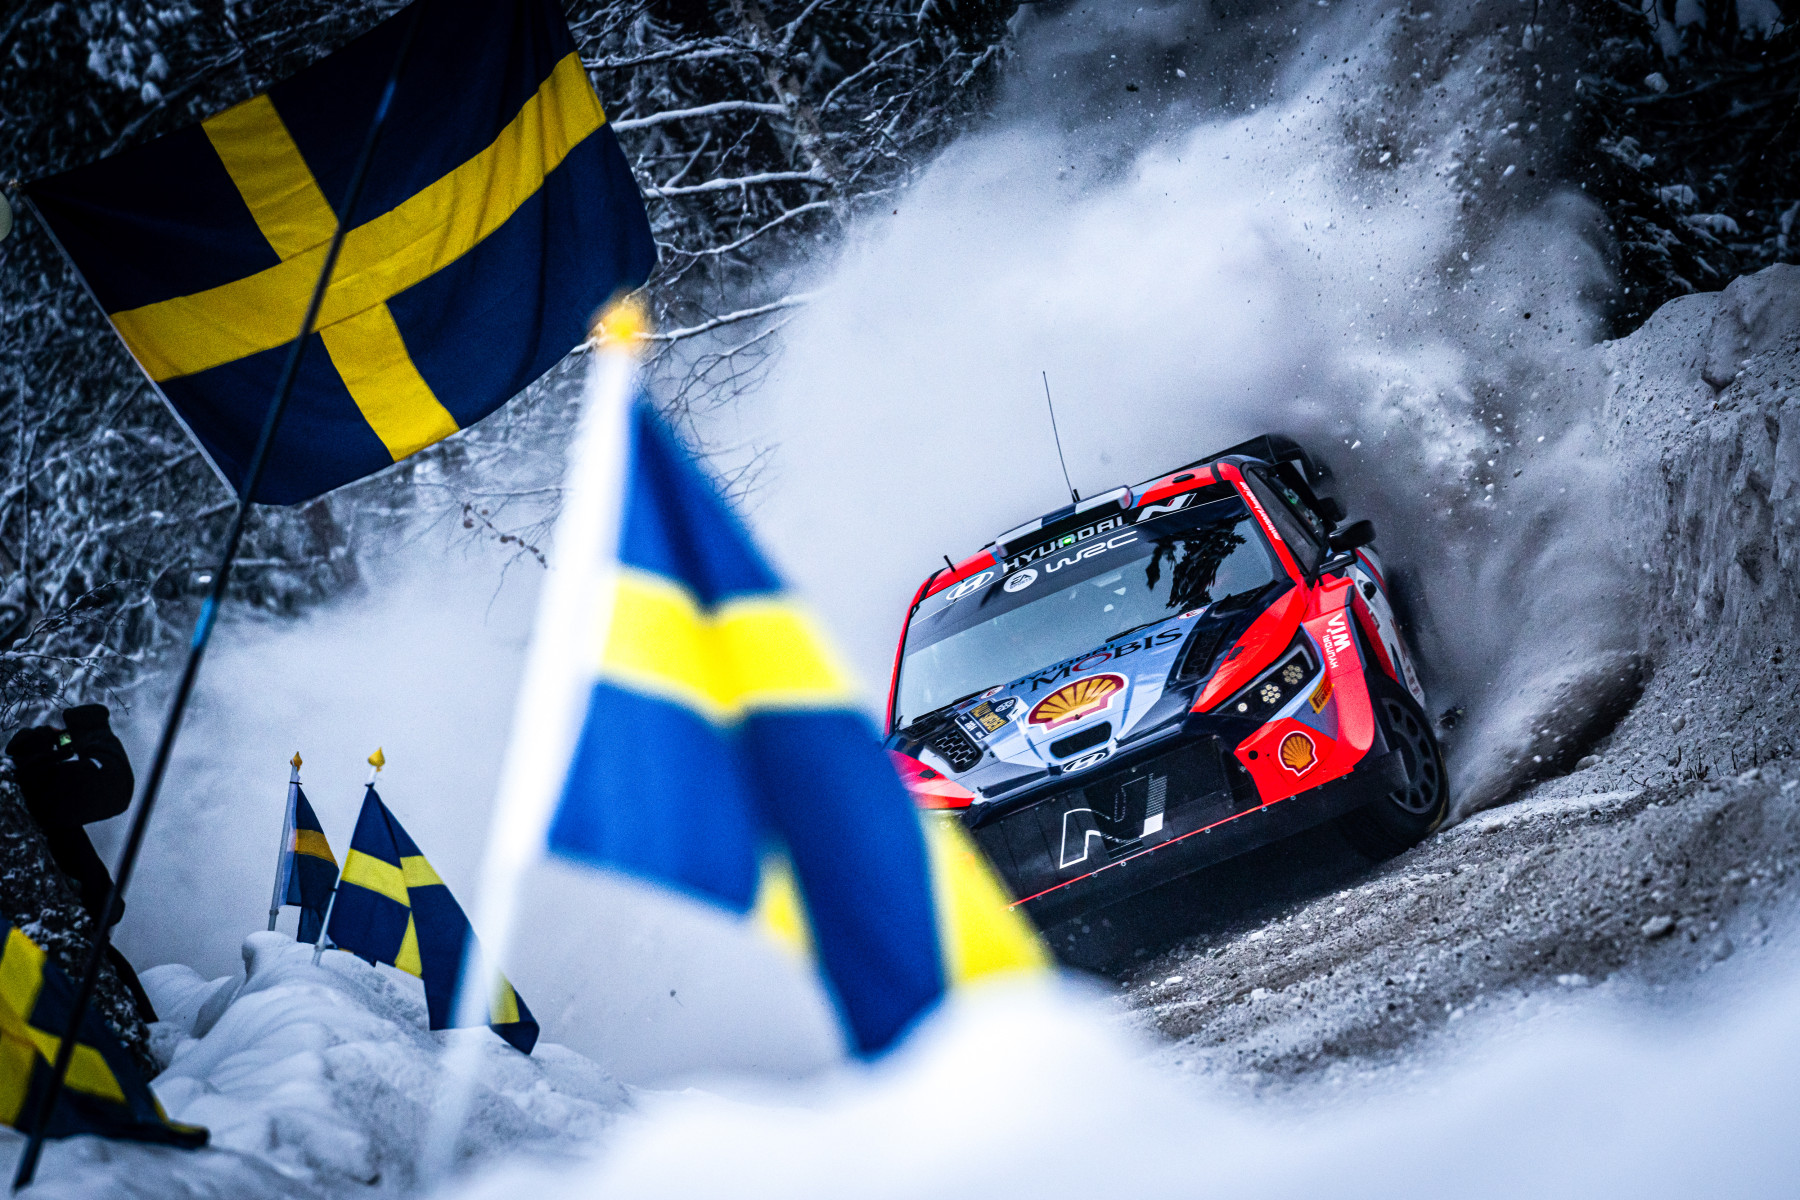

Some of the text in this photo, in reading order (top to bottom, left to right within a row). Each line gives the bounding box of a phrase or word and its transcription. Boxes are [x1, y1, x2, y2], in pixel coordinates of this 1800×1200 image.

[1002, 516, 1123, 573] HYUNDAI
[1045, 530, 1138, 573] WRC
[1010, 644, 1114, 690] HYUNDAI
[1031, 627, 1183, 692] MOBIS
[1322, 634, 1339, 669] HYUNDAI
